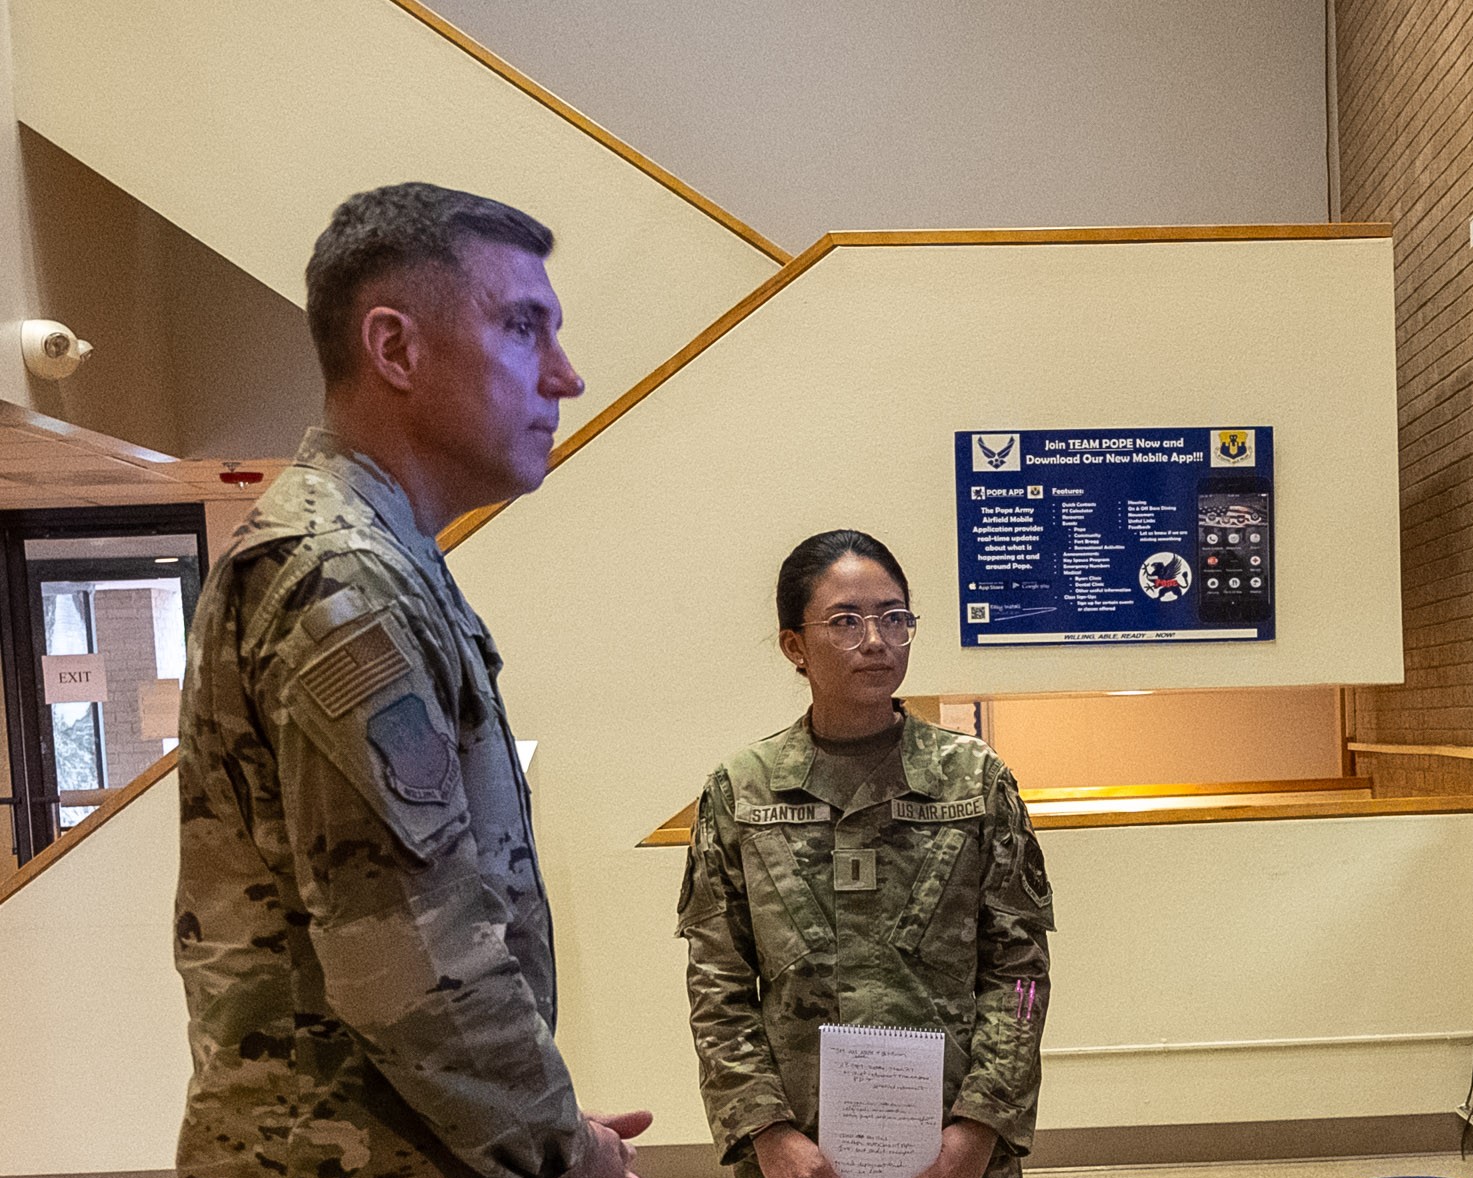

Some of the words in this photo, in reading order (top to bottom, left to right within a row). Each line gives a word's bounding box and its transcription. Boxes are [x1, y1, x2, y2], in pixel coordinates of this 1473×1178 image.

[1045, 440, 1066, 450] Join
[1068, 439, 1099, 449] TEAM
[1102, 439, 1133, 449] POPE
[1136, 439, 1160, 448] Now
[1163, 438, 1183, 447] and
[1026, 454, 1080, 465] Download
[1082, 455, 1103, 464] Our
[1106, 454, 1130, 463] New
[1133, 453, 1168, 463] Mobile
[1170, 452, 1203, 463] App!!!
[972, 526, 1013, 534] Application
[1014, 525, 1044, 533] provides
[1011, 534, 1039, 542] updates
[977, 553, 1015, 561] happening
[1012, 562, 1033, 570] Pope.
[58, 670, 92, 685] EXIT
[752, 805, 815, 823] STANTON
[918, 804, 938, 820] AIR
[941, 799, 980, 820] FORCE
